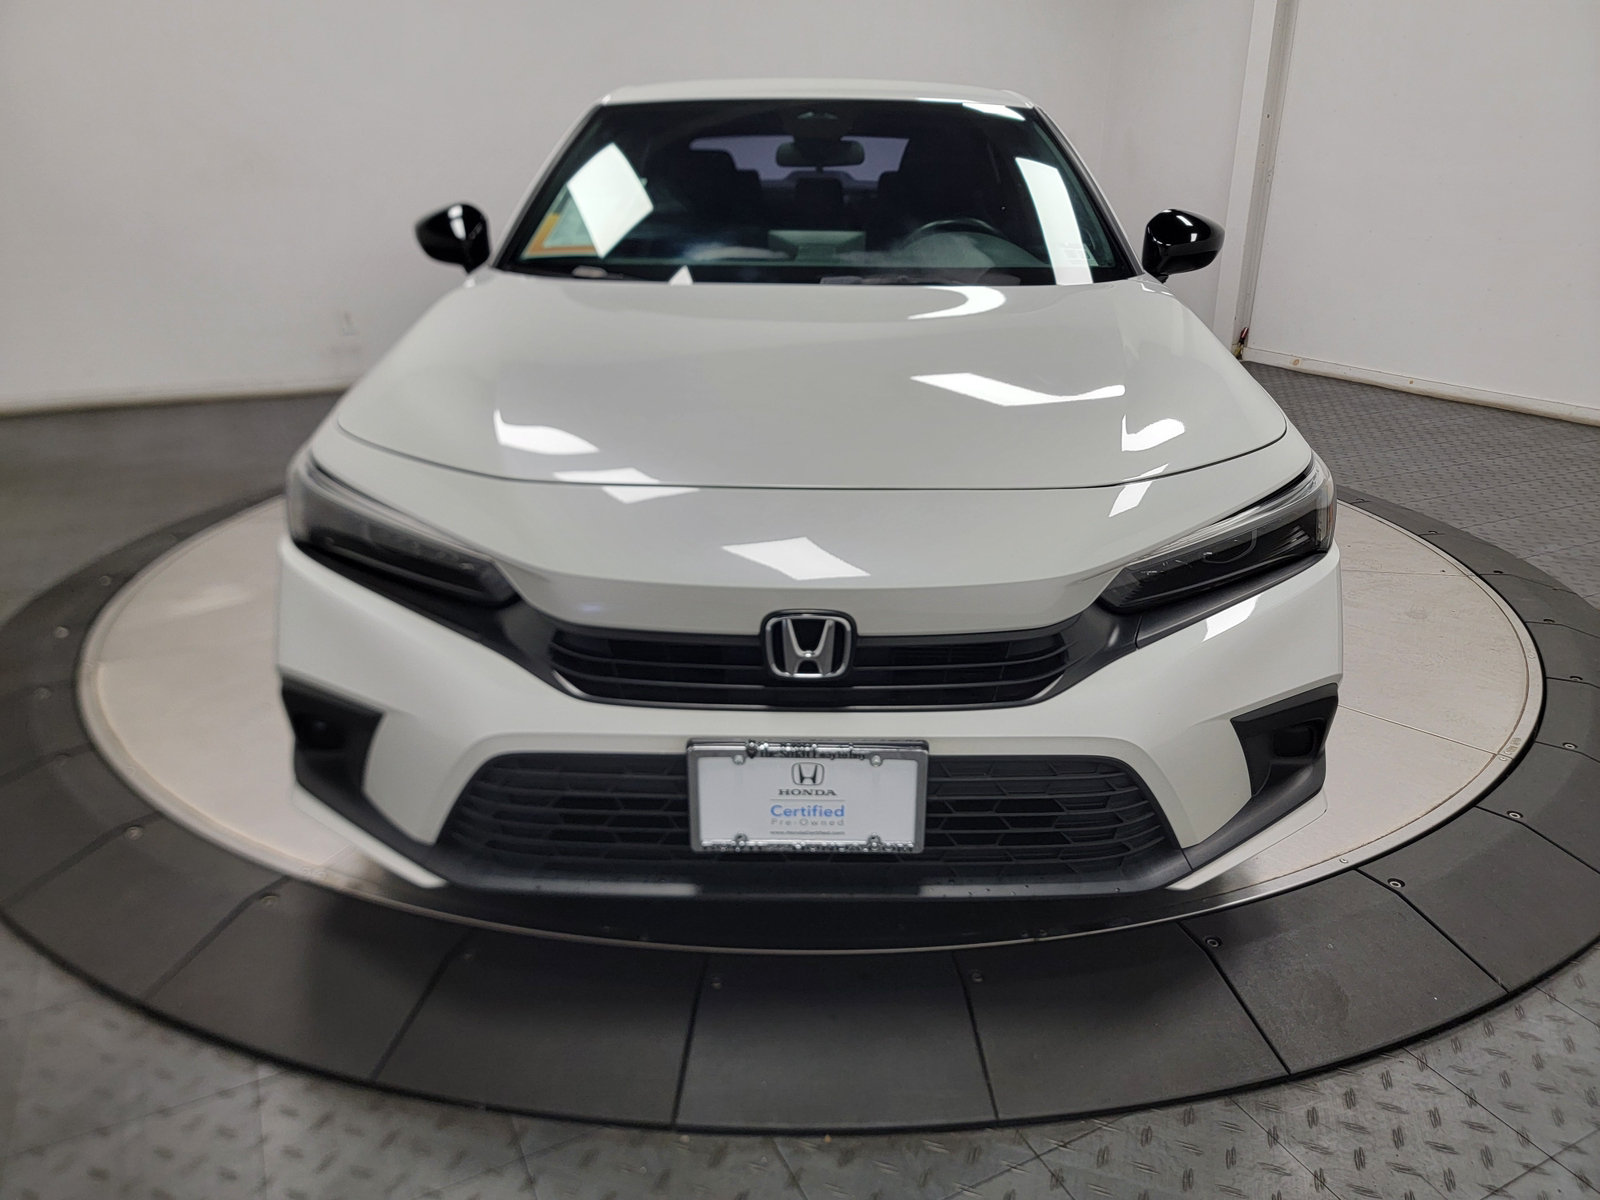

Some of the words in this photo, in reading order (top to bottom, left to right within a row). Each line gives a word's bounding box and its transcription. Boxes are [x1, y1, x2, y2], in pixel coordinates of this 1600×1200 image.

[778, 788, 837, 796] HONDA
[770, 804, 845, 817] Certified
[770, 818, 845, 826] Pre-Owned
